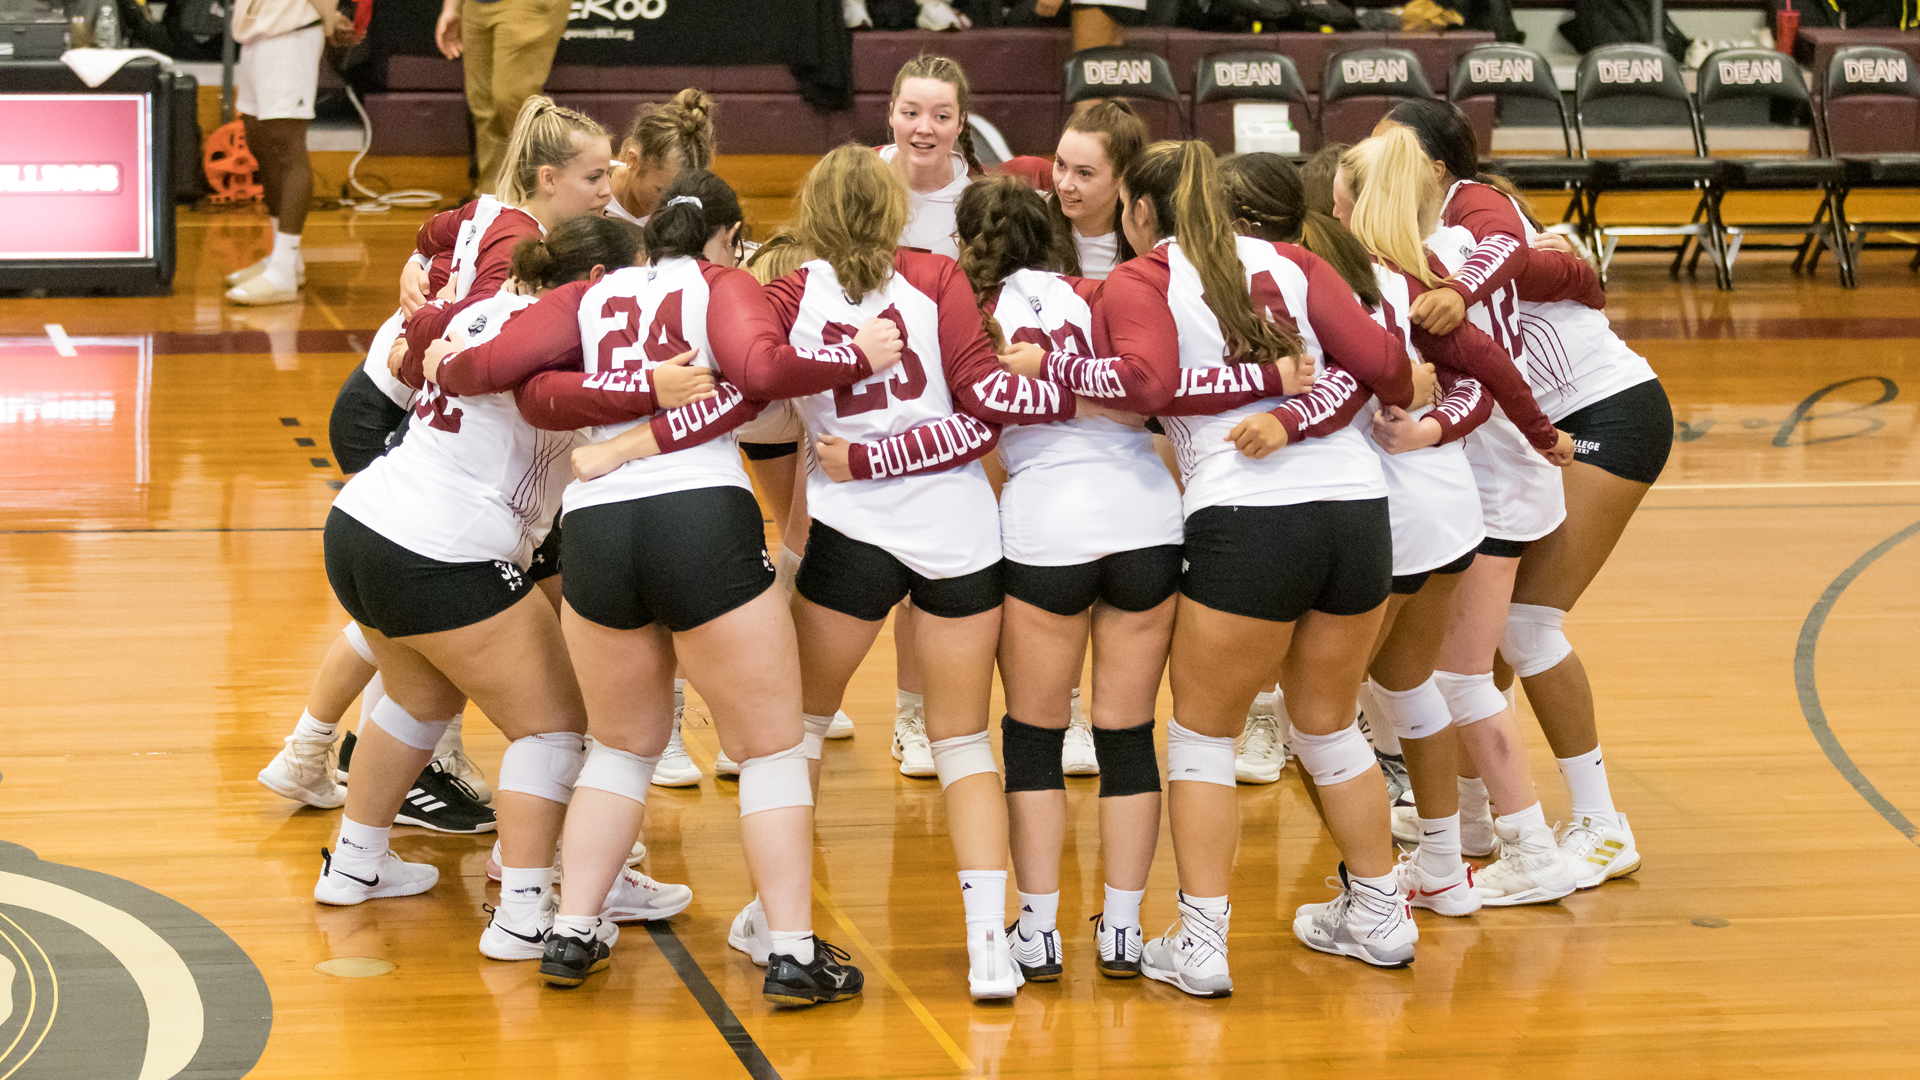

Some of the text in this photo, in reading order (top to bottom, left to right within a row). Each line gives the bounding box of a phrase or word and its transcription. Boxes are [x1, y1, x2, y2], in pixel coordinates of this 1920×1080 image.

[1083, 60, 1151, 84] DEAN
[1214, 61, 1281, 86] DEAN
[1341, 59, 1407, 83] DEAN
[1469, 58, 1534, 82] DEAN
[1598, 58, 1663, 83] DEAN
[1718, 60, 1783, 84] DEAN
[1843, 58, 1907, 82] DEAN
[0, 164, 118, 192] LLDOGS
[596, 288, 692, 374] 24
[667, 382, 743, 441] BULLD
[867, 413, 992, 480] BULLDOGS
[1573, 439, 1600, 451] LLEGE
